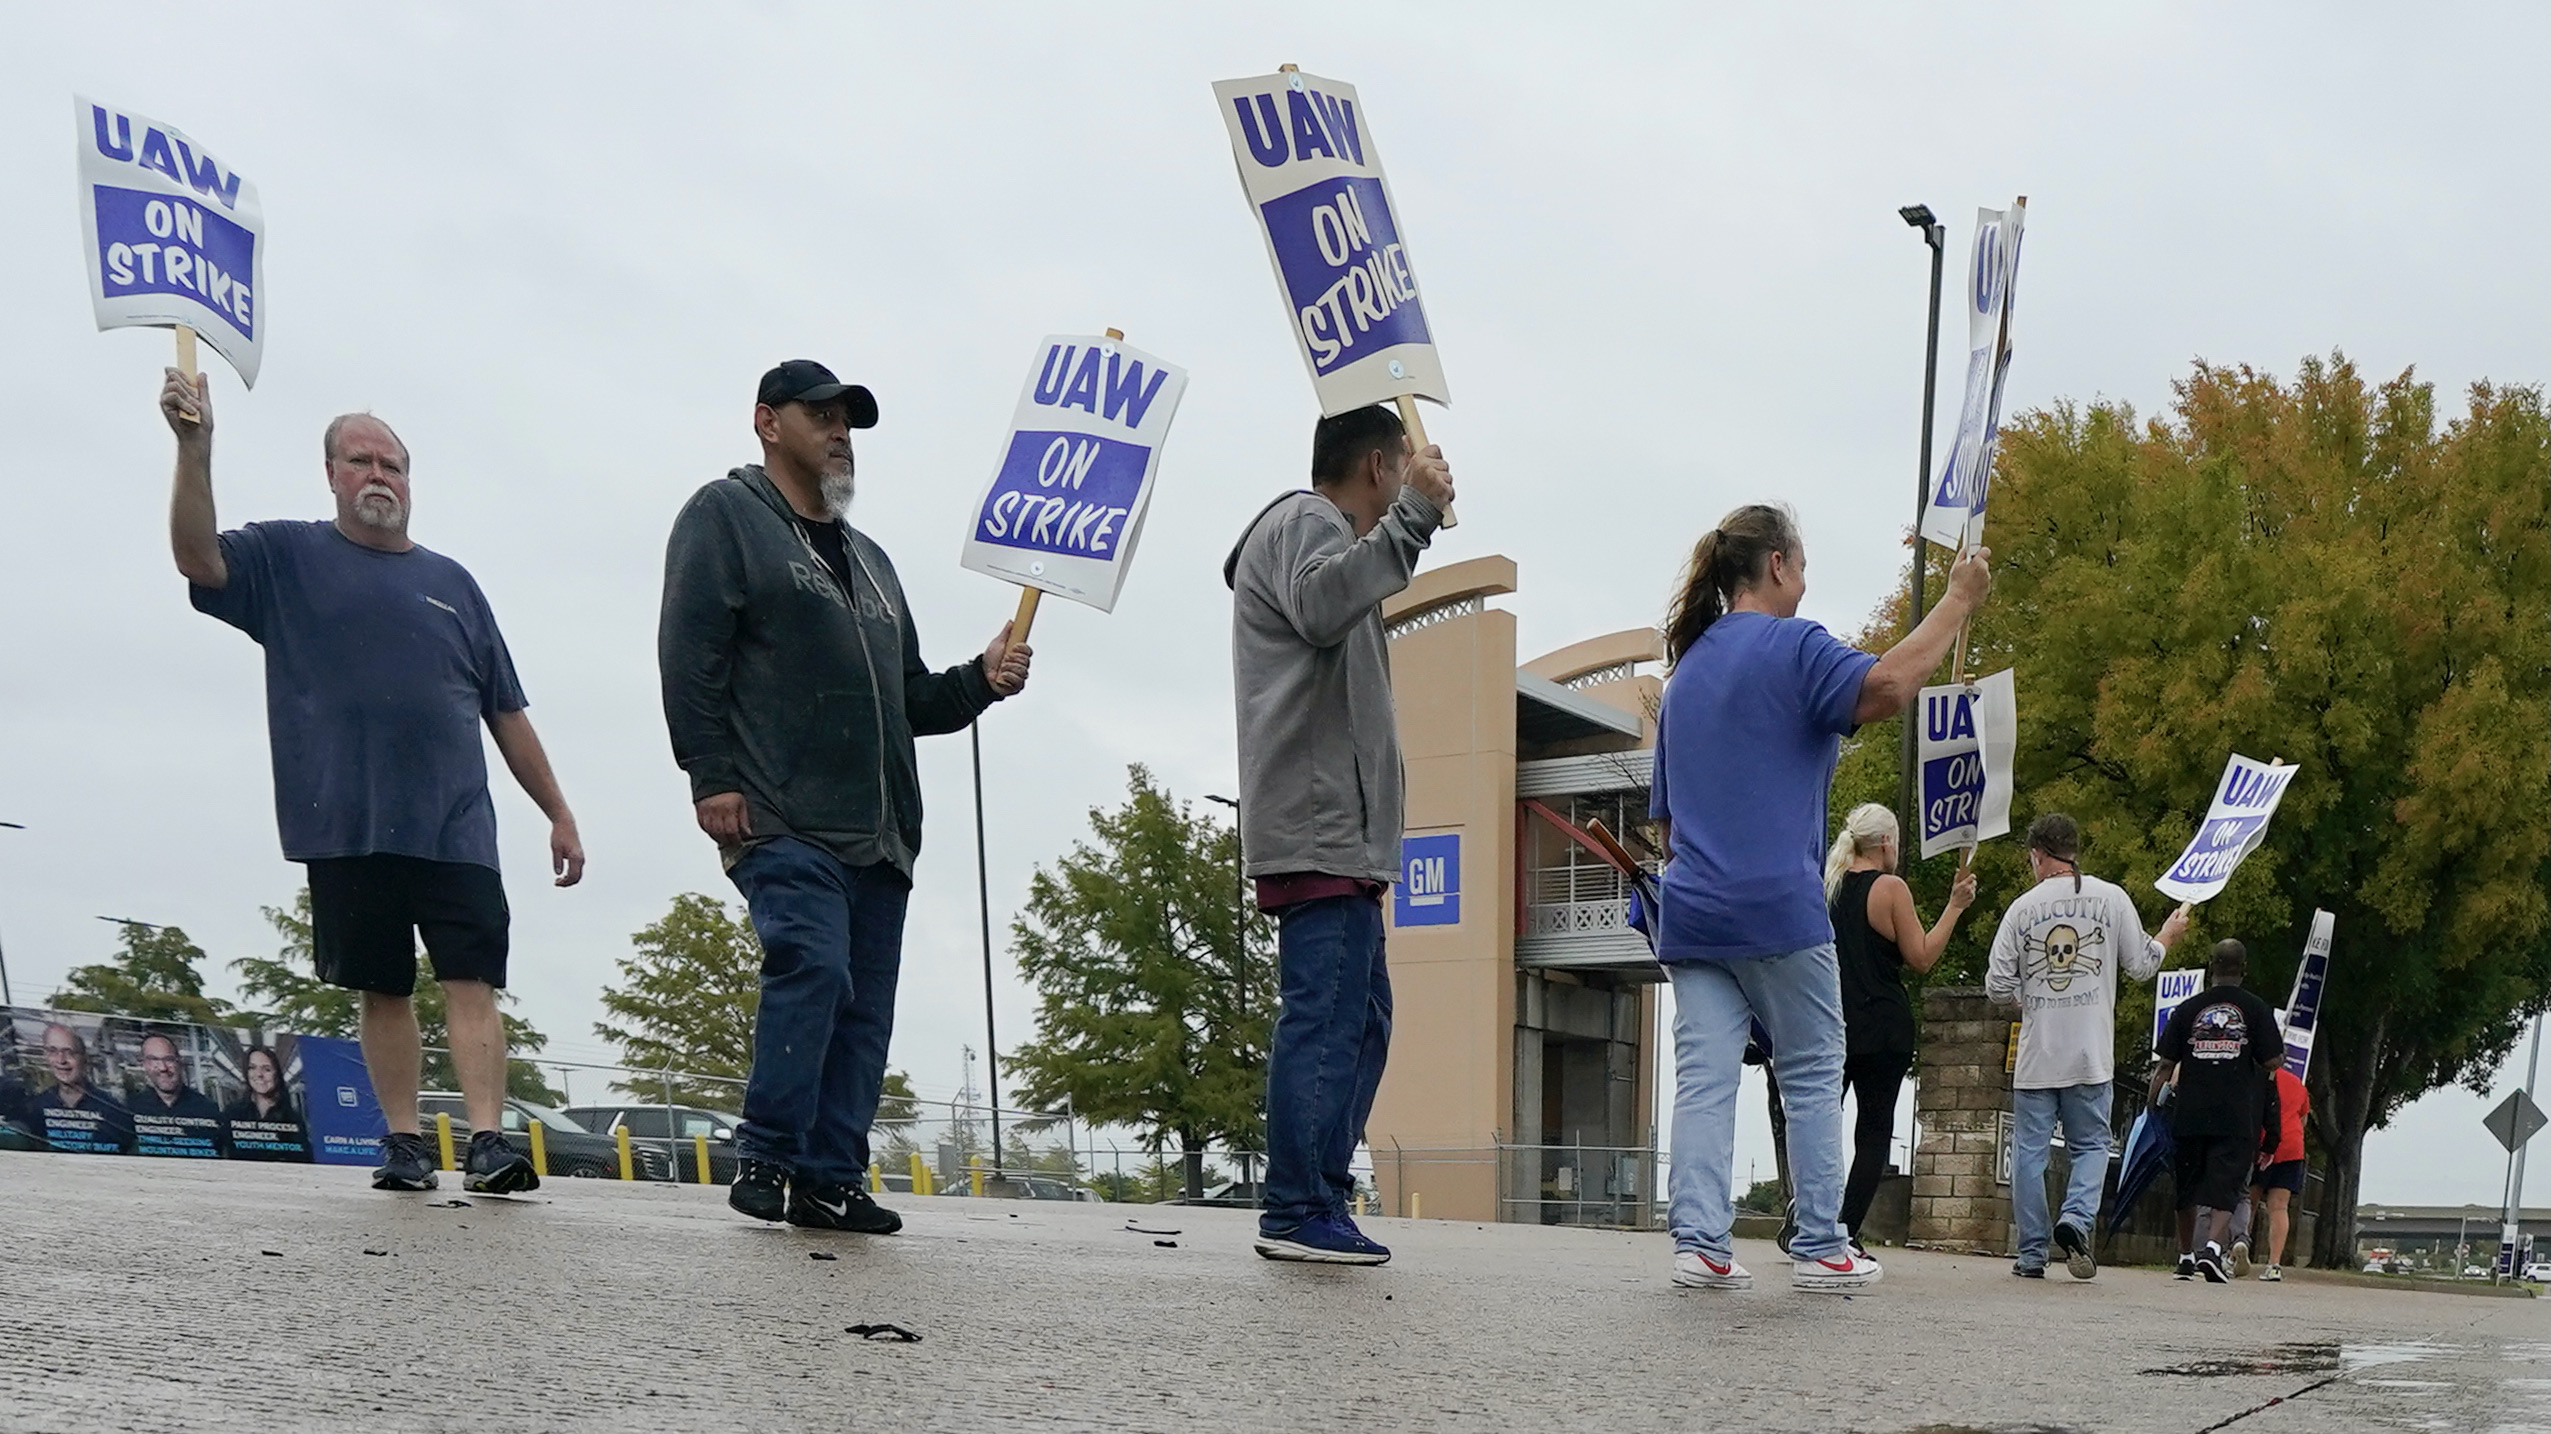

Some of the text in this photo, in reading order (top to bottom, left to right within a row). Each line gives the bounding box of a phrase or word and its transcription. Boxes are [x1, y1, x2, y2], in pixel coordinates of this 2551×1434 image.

[1233, 90, 1365, 168] UAW
[92, 104, 241, 210] UAW
[145, 200, 203, 249] ON
[1312, 184, 1372, 267] ON
[107, 242, 251, 326] STRIKE
[1301, 242, 1417, 368] STRIKE
[1033, 344, 1168, 429] UAW
[1038, 436, 1100, 490] ON
[985, 490, 1127, 552] STRIKE
[1929, 693, 1981, 741] UA
[1948, 755, 1980, 789] ON
[2222, 765, 2288, 808] UAW
[1928, 791, 1980, 832] STRI
[2211, 821, 2242, 847] ON
[1409, 857, 1444, 895] GM
[2178, 845, 2240, 878] STRIKE
[2018, 897, 2111, 937] CALCUTTA
[2162, 974, 2197, 998] UAW
[2196, 1041, 2240, 1051] ARLINGTON
[230, 1120, 299, 1132] PAINT PROCESS
